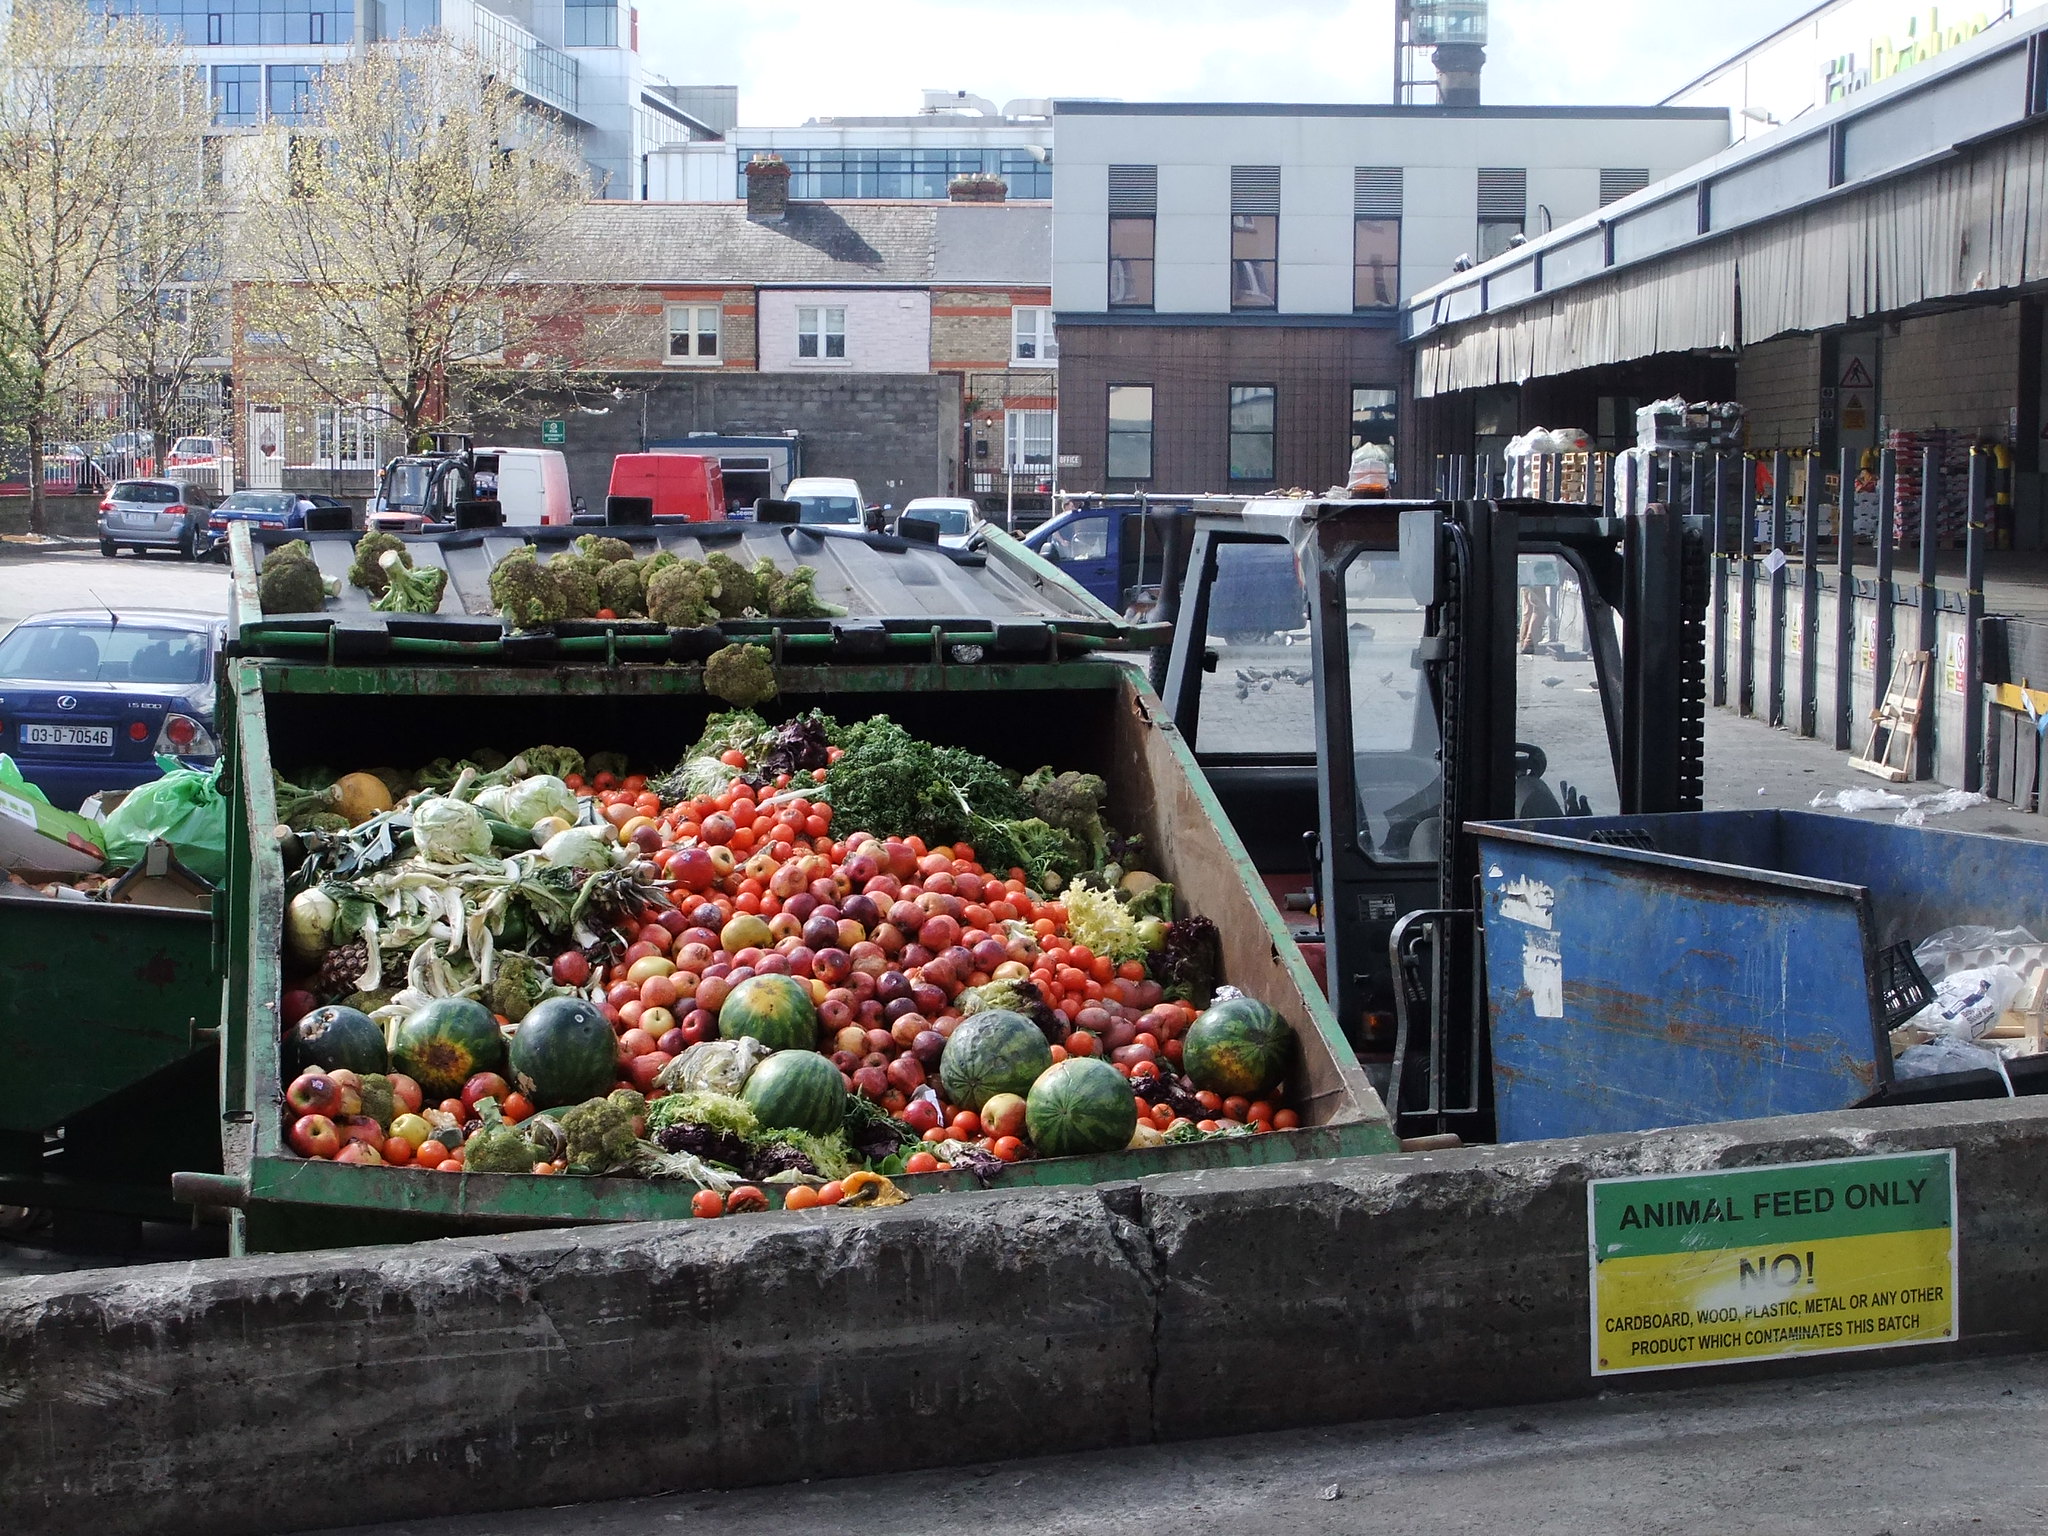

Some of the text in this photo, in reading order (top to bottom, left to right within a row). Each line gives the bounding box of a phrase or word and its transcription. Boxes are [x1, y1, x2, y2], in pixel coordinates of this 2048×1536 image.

[1059, 455, 1079, 464] OFFICE
[31, 727, 108, 744] 03-D-70546
[1619, 1178, 1927, 1231] ANIMAL FEED ONLY
[1739, 1251, 1815, 1290] NO!
[1605, 1286, 1944, 1333] CARDBOARD, WOOD, PLASTIC, METAL OR ANY OTHER
[1631, 1314, 1920, 1356] PRODUCT WHICH CONTAMINATES THIS BATCH
